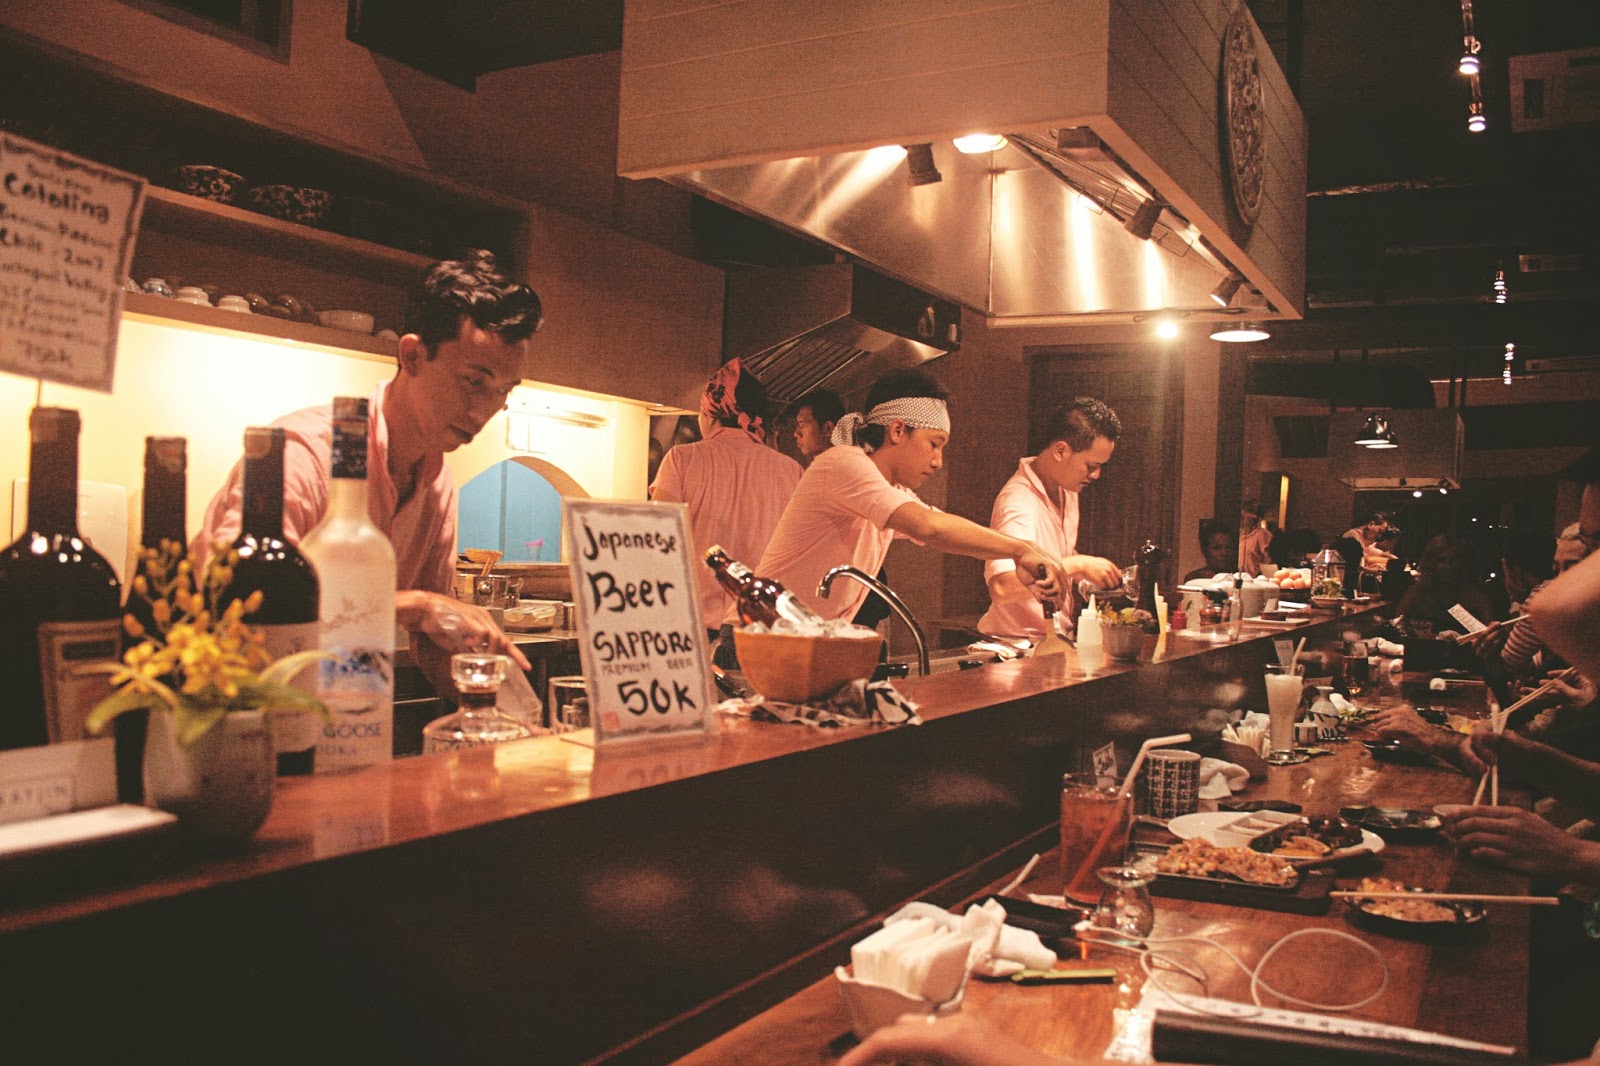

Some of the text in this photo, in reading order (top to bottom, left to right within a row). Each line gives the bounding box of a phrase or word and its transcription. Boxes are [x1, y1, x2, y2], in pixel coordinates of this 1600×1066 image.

[583, 523, 677, 561] Japanese
[586, 571, 674, 613] Beer
[593, 631, 693, 662] SAPPORO
